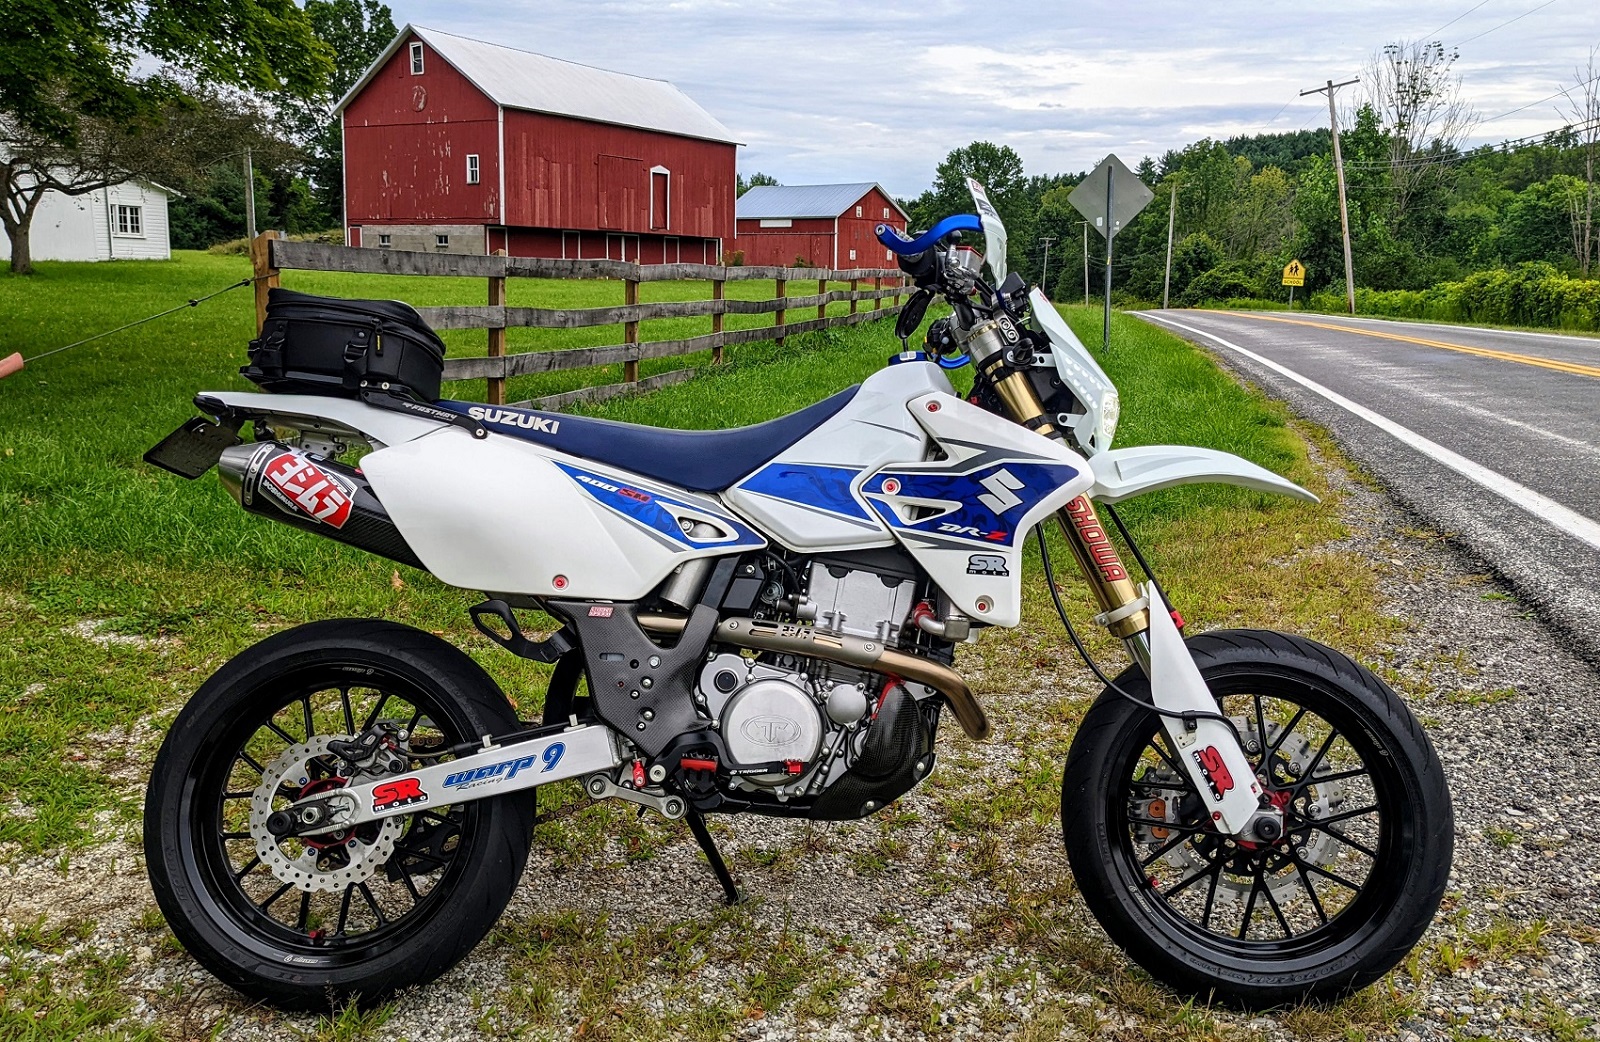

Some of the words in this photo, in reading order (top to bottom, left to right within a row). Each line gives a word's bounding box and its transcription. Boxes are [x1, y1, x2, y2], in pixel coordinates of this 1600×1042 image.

[468, 406, 560, 435] SUZUKI
[262, 480, 299, 512] YOSHIMURA
[937, 522, 1008, 541] DR-Z
[1065, 495, 1126, 582] SHOWA
[968, 554, 1008, 572] SR
[442, 754, 537, 788] warp
[540, 741, 566, 773] 9
[1193, 752, 1221, 801] moto
[1198, 745, 1235, 796] SR
[372, 778, 427, 806] SR
[455, 777, 504, 792] Racing
[374, 795, 428, 811] moto
